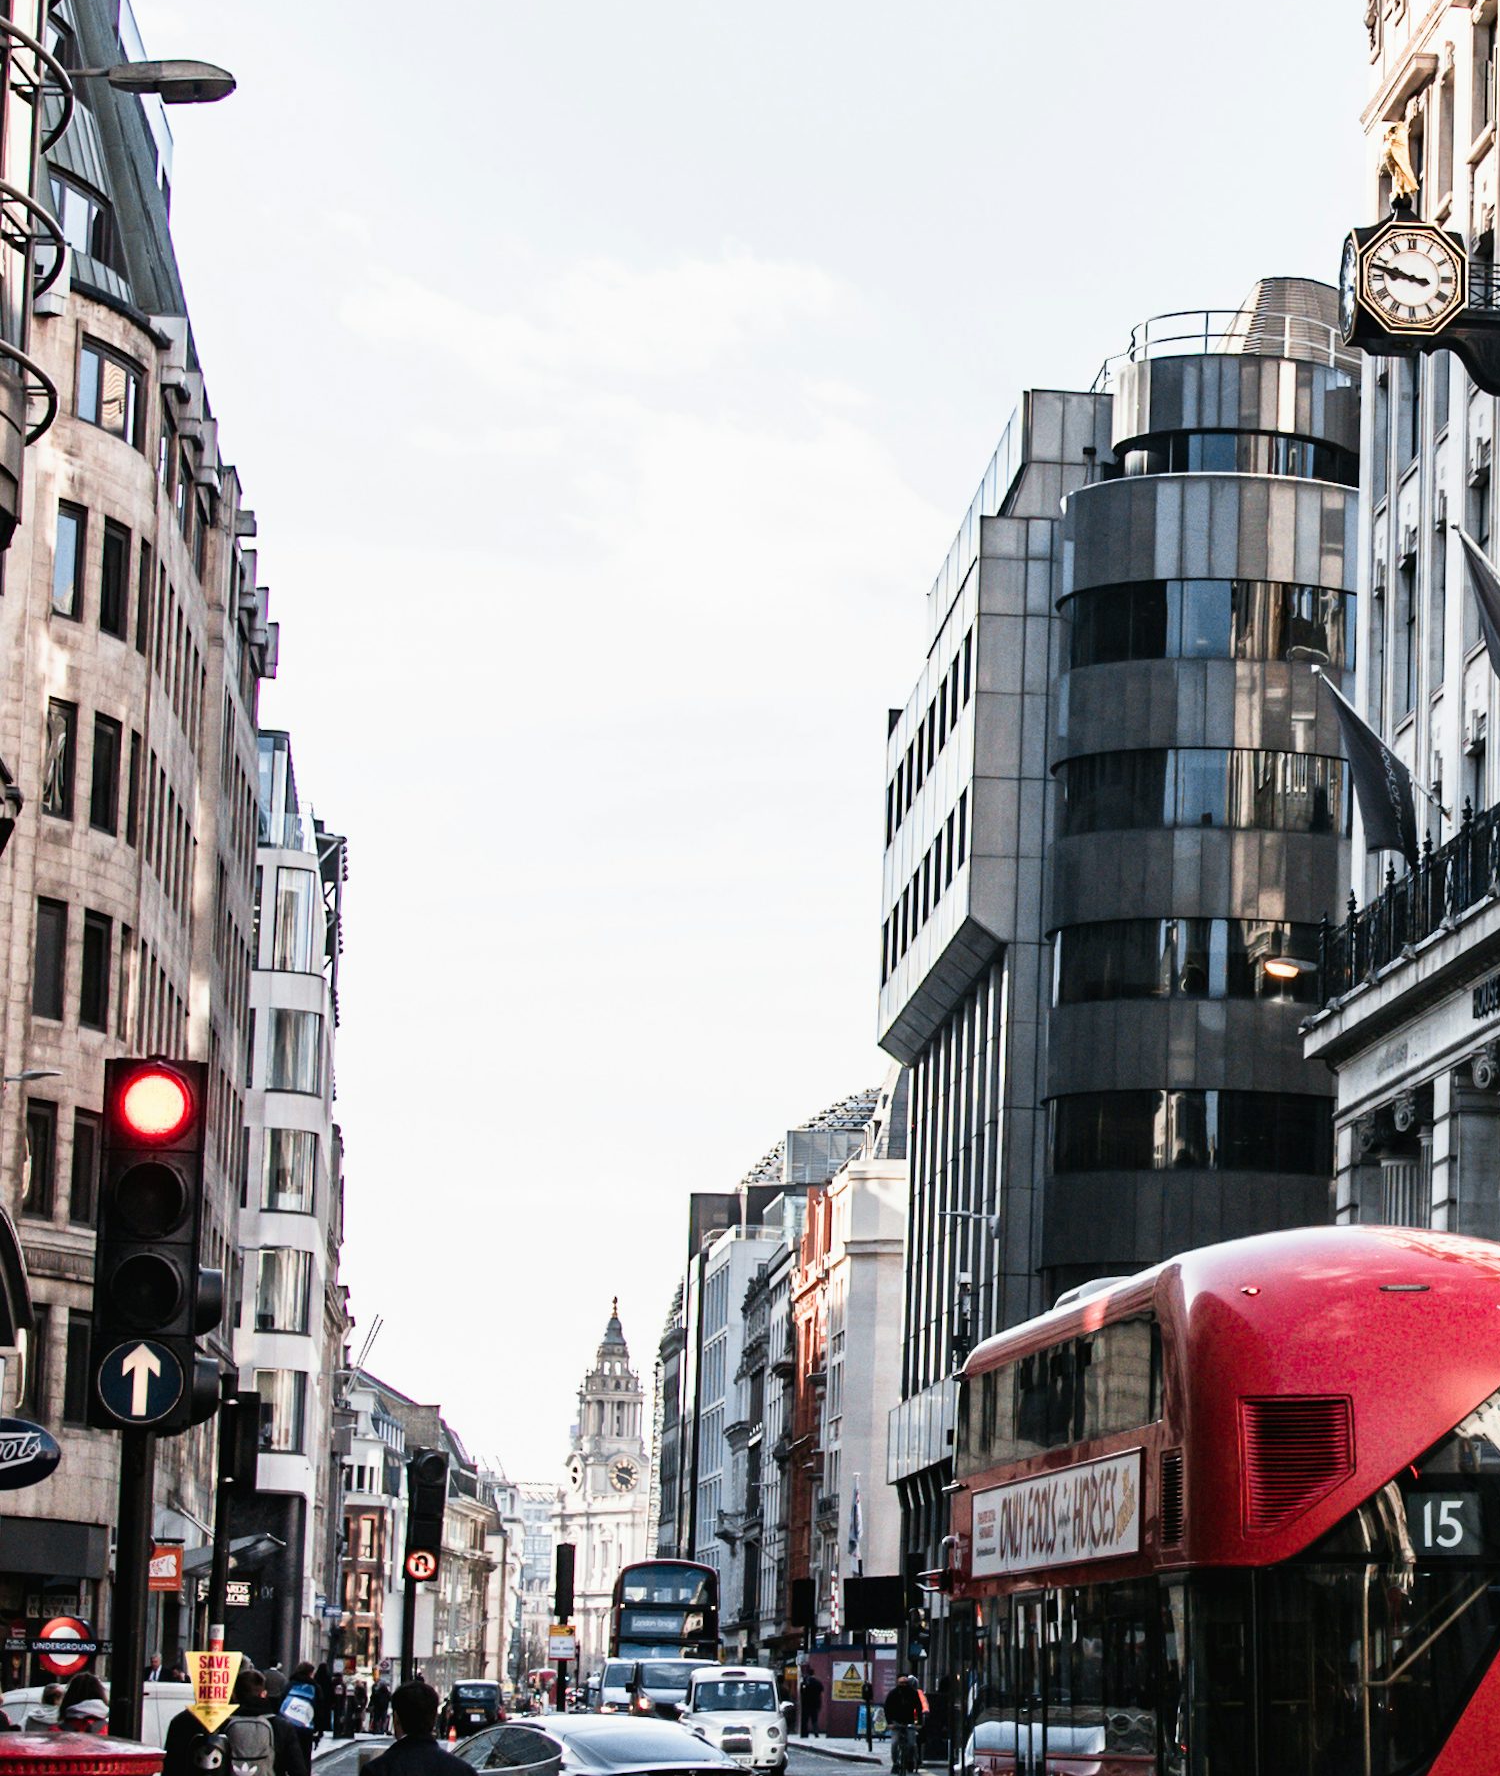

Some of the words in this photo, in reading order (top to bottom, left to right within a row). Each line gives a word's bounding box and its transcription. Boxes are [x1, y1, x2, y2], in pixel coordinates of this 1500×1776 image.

[1000, 1489, 1025, 1562] ONLY
[1026, 1481, 1058, 1561] FOOLS
[1072, 1466, 1118, 1555] HORSES
[1424, 1500, 1464, 1548] 15
[32, 1642, 97, 1652] UNDERGROUND
[199, 1655, 230, 1669] SAVE
[198, 1670, 229, 1684] £150
[198, 1685, 228, 1699] HERE
